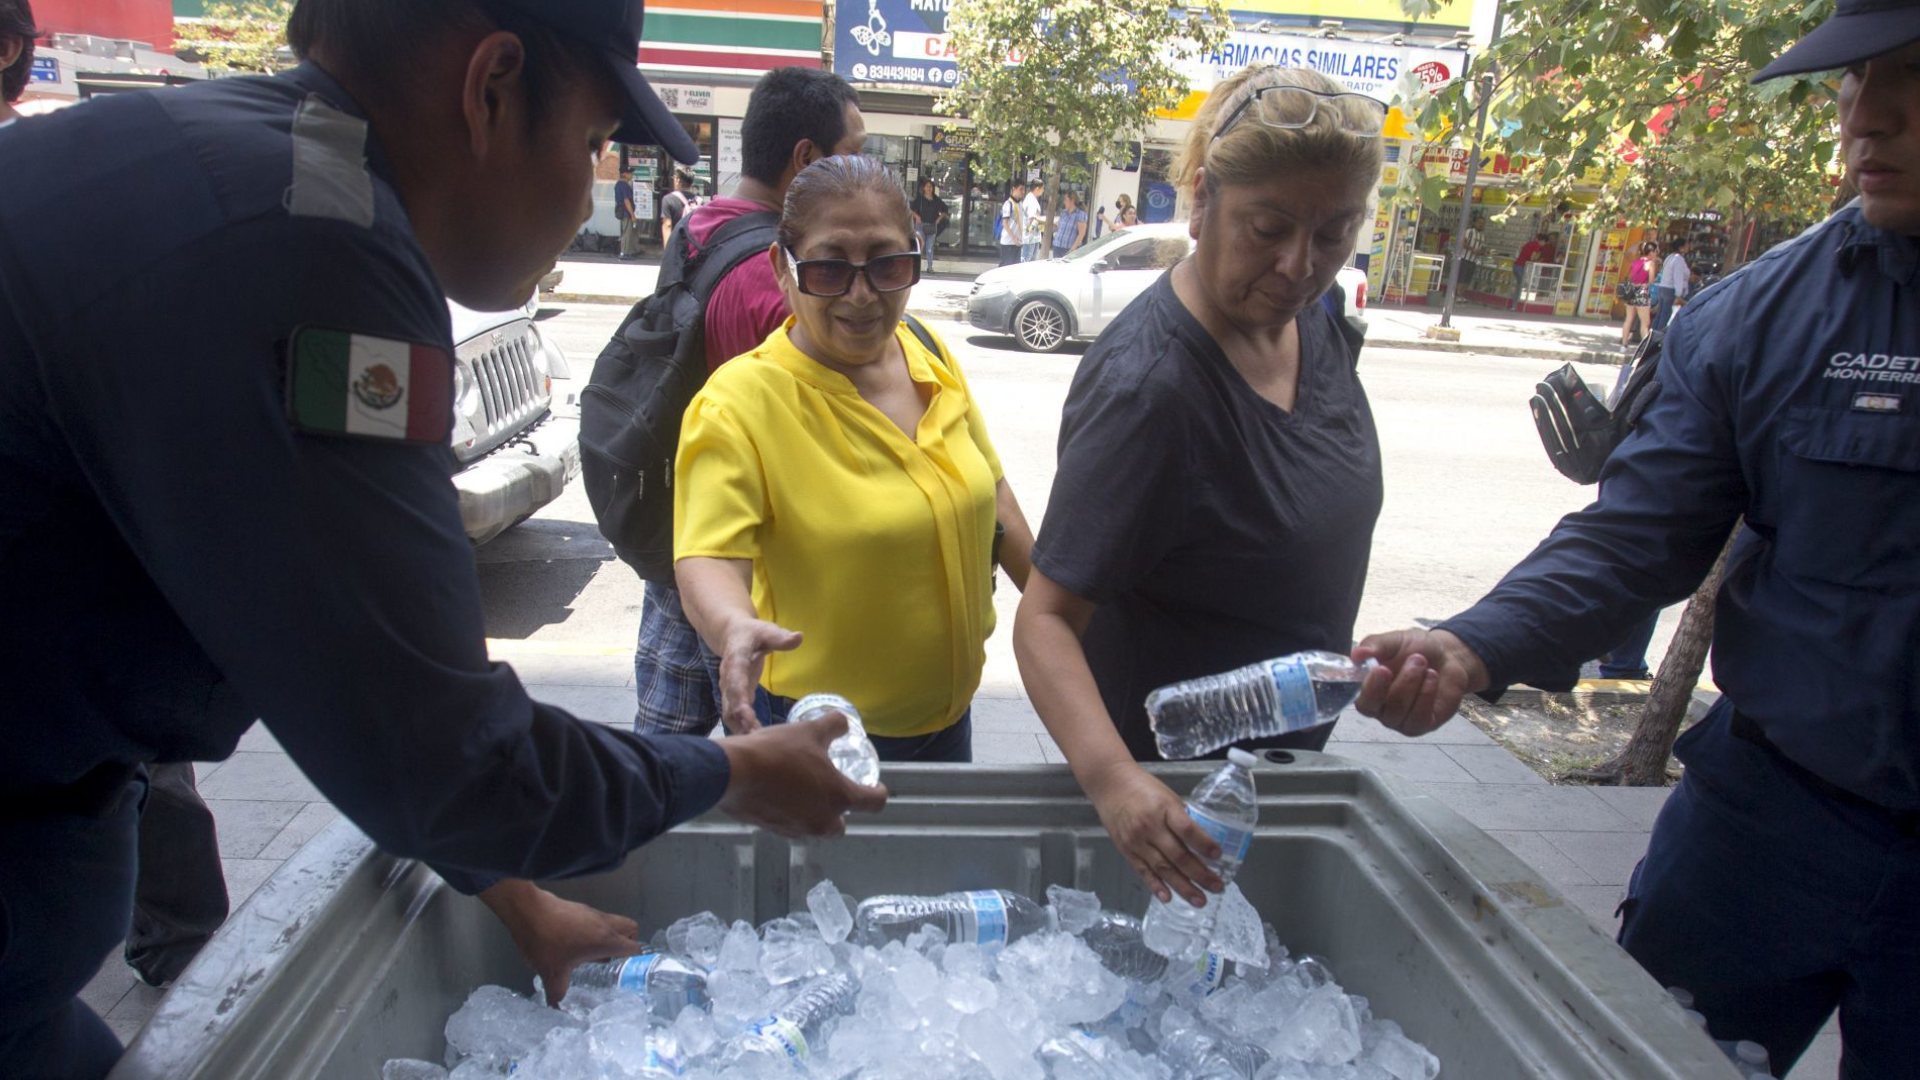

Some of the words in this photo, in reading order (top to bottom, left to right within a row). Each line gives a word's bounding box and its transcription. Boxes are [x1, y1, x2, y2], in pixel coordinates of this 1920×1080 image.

[869, 65, 925, 82] 83443494
[1201, 43, 1301, 67] FARMACIAS
[1307, 49, 1399, 80] SIMILARES
